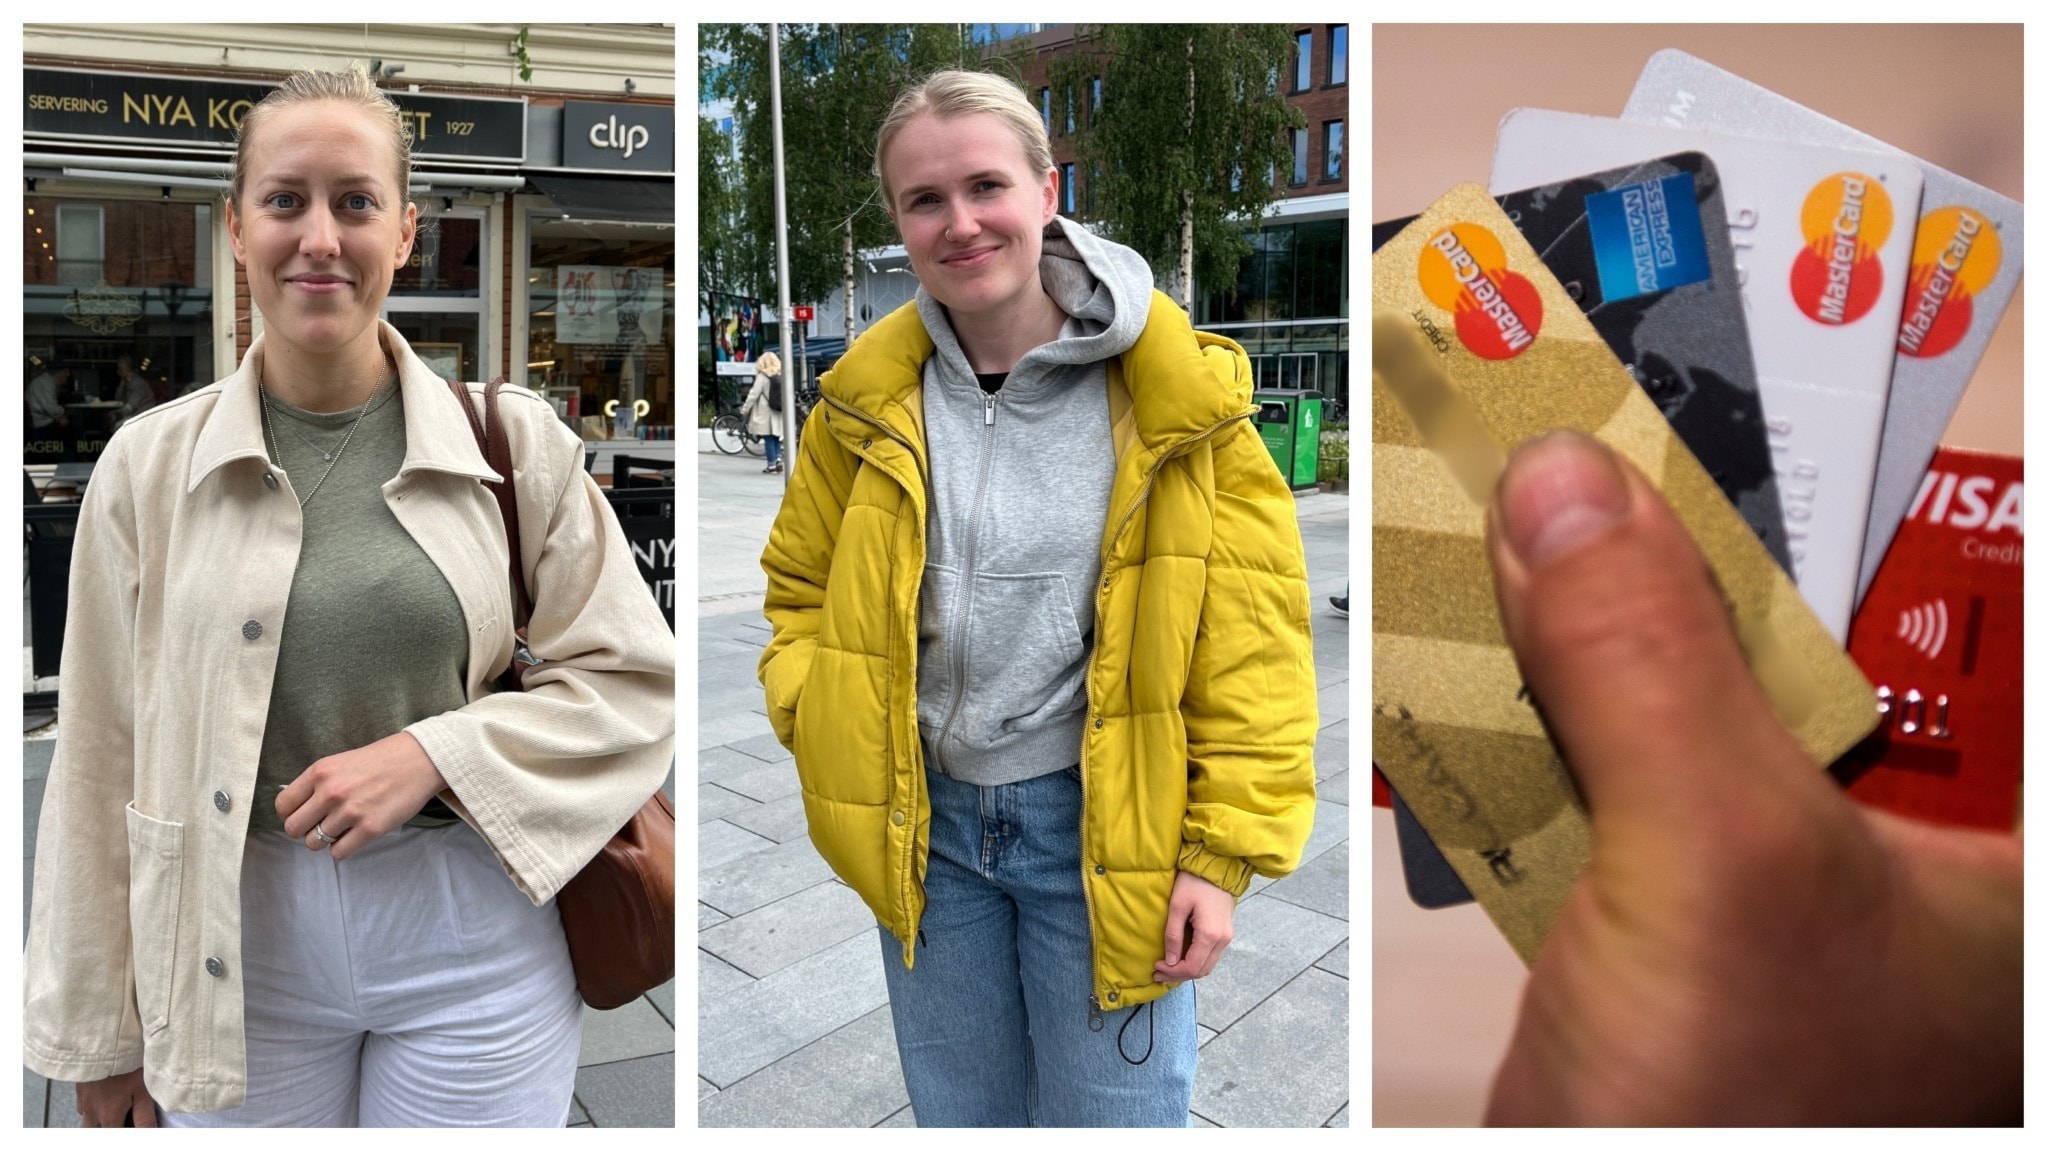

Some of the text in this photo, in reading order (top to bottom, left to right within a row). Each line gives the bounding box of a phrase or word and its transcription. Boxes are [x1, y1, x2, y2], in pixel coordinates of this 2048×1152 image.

[28, 94, 108, 114] SERVERING
[123, 92, 196, 127] NYA
[445, 121, 474, 135] 1927
[589, 115, 649, 159] clip
[1624, 189, 1658, 293] AMERICAN
[1647, 179, 1676, 267] EXPRESS
[1818, 176, 1867, 322] MasterCard
[1430, 230, 1533, 351] MasterCard
[1900, 211, 1981, 353] MasterCard
[1411, 309, 1448, 353] CREDIT
[25, 441, 107, 454] AGERI BUTI
[631, 538, 675, 570] NY
[646, 579, 675, 609] IT
